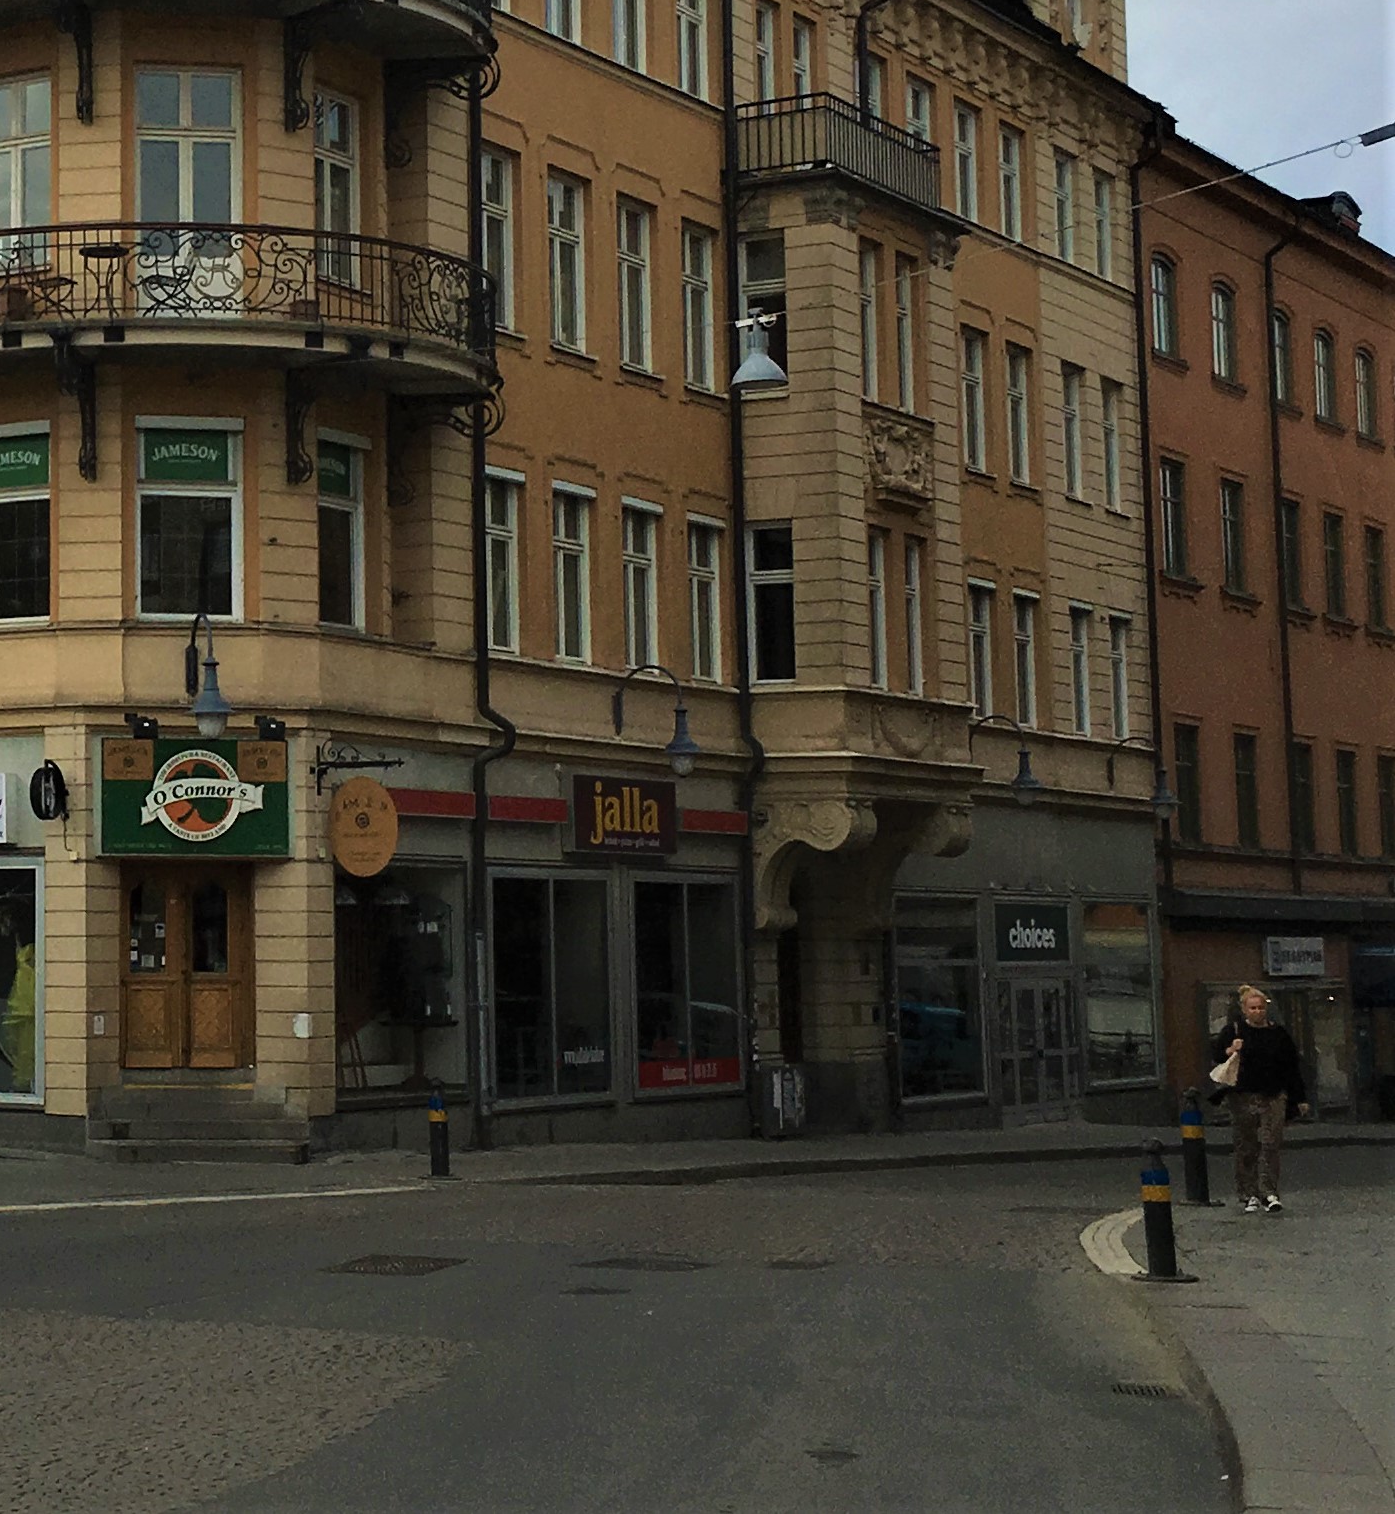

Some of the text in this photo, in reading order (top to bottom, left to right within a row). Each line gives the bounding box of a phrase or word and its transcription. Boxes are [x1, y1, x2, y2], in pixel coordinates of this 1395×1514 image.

[152, 443, 218, 461] JAMESON
[154, 783, 248, 806] O'Connor's
[589, 780, 660, 844] jalla
[1009, 918, 1056, 949] choices
